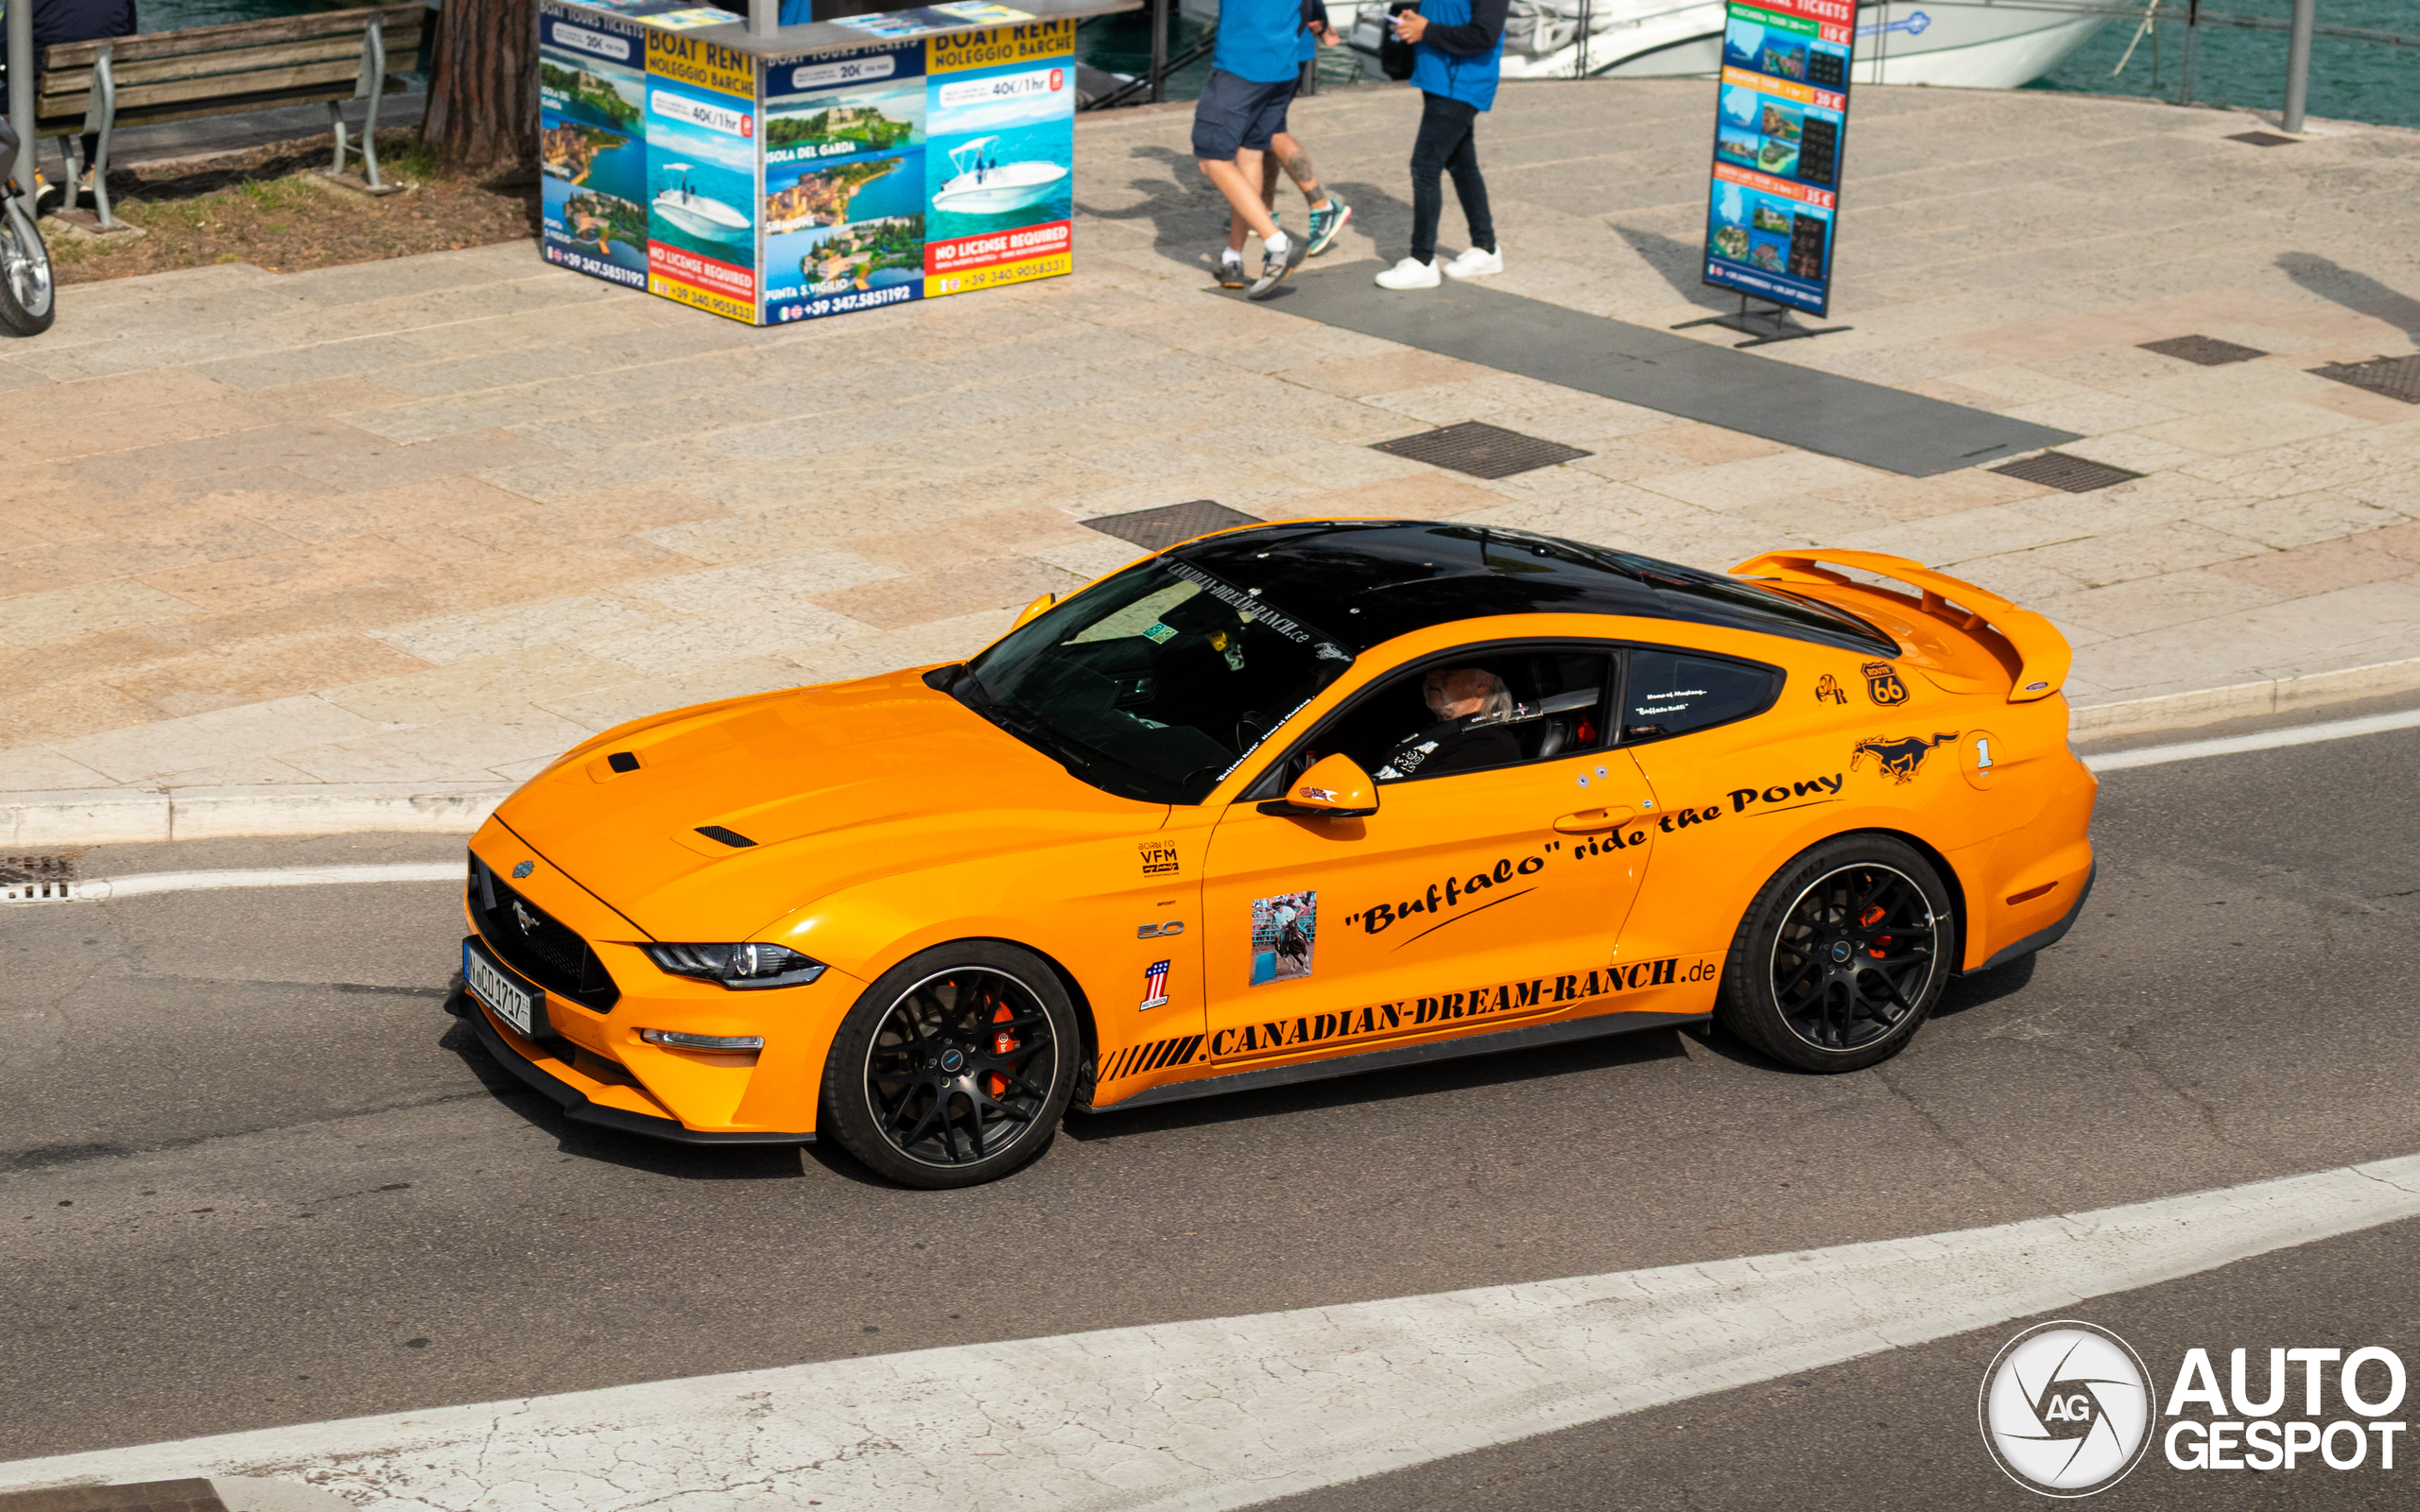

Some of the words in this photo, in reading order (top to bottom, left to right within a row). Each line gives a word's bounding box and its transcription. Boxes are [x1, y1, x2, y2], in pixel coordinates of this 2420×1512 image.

[649, 29, 697, 61] BOAT
[706, 43, 752, 76] RENT
[935, 44, 1013, 67] NOLEGGIO
[1019, 35, 1072, 57] BARCHE
[649, 57, 707, 83] NOLEGGIO
[711, 72, 754, 96] BARCHE
[840, 65, 861, 78] 20€
[797, 145, 817, 160] DEL
[819, 141, 856, 158] GARDA
[935, 245, 956, 261] NO
[959, 236, 1008, 257] LICENSE
[1010, 226, 1068, 249] REQUIRED
[563, 252, 581, 267] +39
[582, 257, 645, 287] 347.5851192
[649, 247, 666, 261] NO
[666, 251, 702, 274] LICENSE
[704, 264, 753, 287] REQUIRED
[766, 286, 798, 301] PUNTA
[804, 300, 830, 316] +39
[832, 286, 910, 312] 347.5851192
[1867, 665, 1890, 677] ROUTE
[1874, 677, 1904, 702] 66
[1976, 738, 1993, 769] 1
[1574, 829, 1648, 861] ride
[1657, 804, 1723, 833] the
[1727, 772, 1843, 813] Pony
[1140, 849, 1178, 864] VFM
[1137, 920, 1184, 939] 5.0
